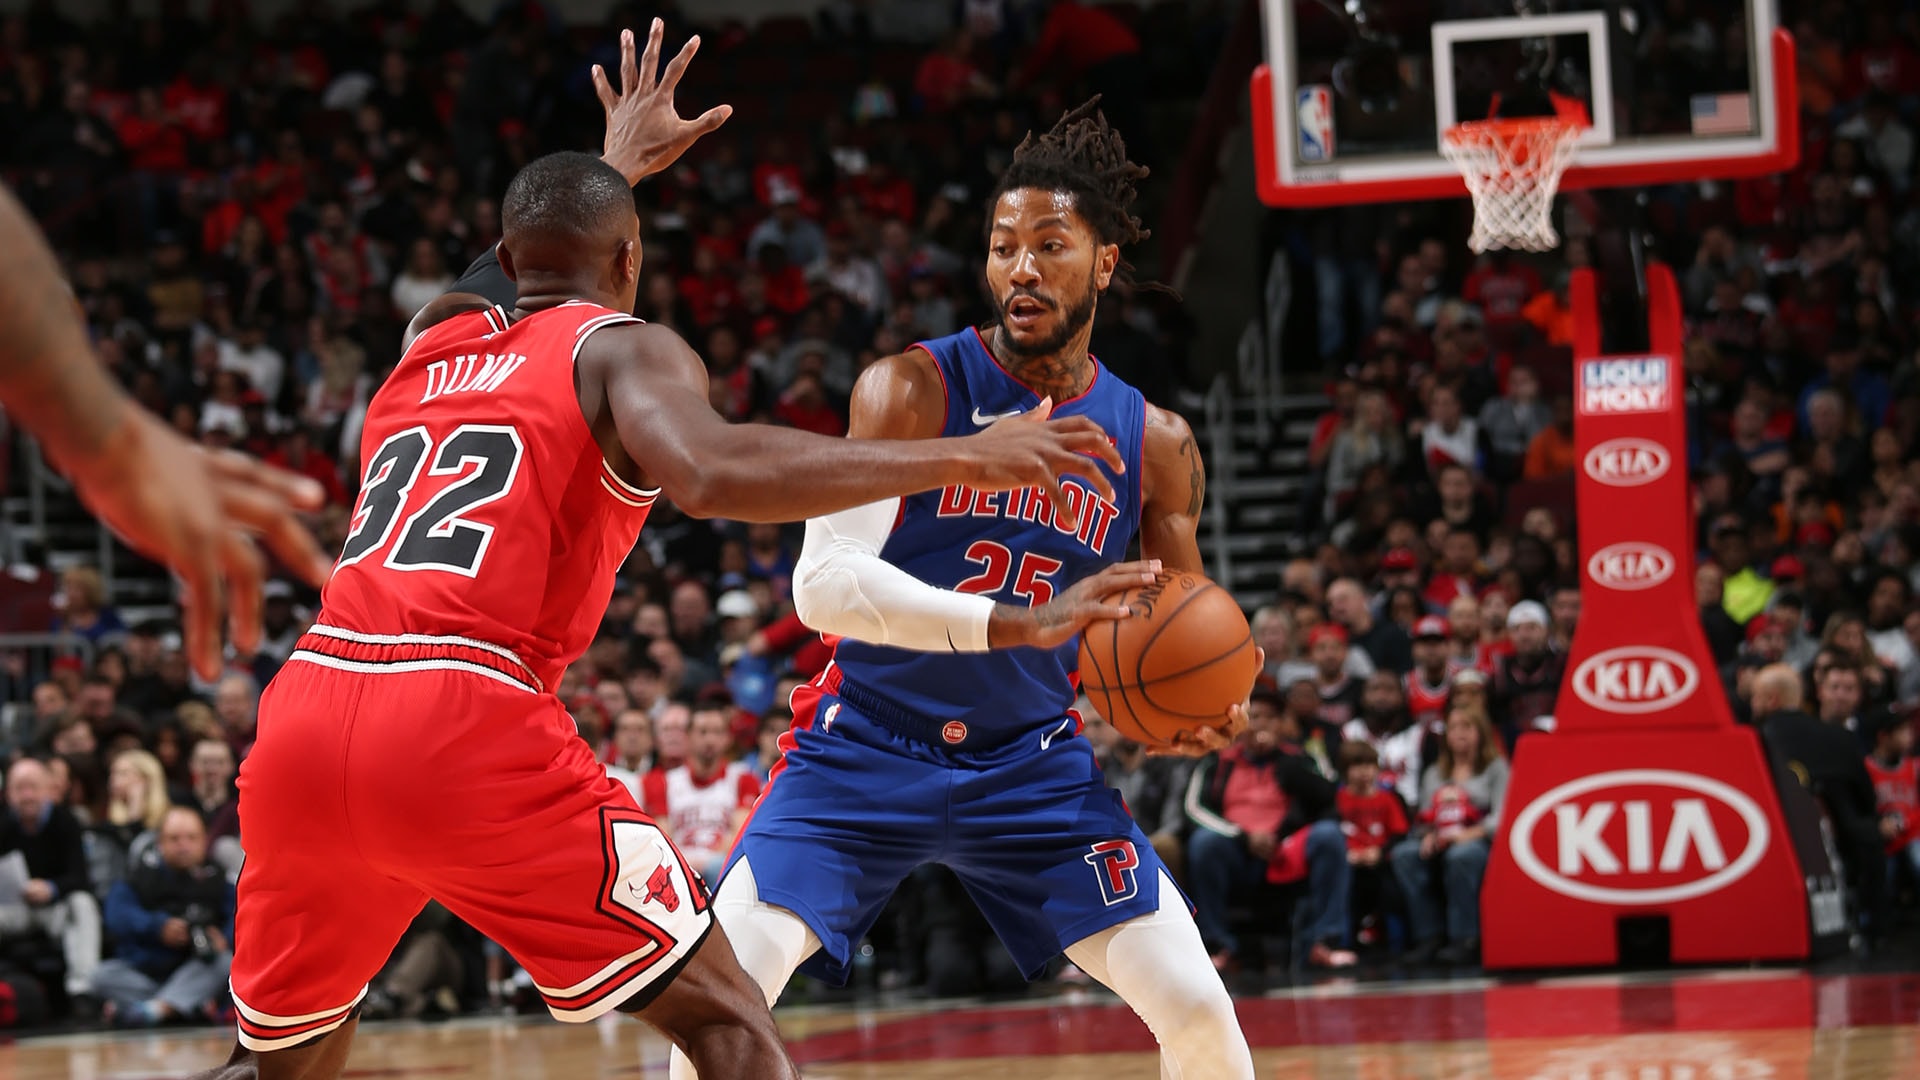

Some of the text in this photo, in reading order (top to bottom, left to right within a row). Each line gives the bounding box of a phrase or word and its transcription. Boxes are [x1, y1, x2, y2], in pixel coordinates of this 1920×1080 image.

[420, 353, 526, 404] DUNN
[1585, 359, 1666, 388] LIQUI
[1585, 386, 1664, 412] MOLY
[1600, 447, 1657, 476] KIA
[331, 424, 524, 578] 32
[954, 540, 1063, 609] 25
[1601, 551, 1661, 582] KIA
[1594, 659, 1678, 700] KIA
[1553, 798, 1727, 874] KIA
